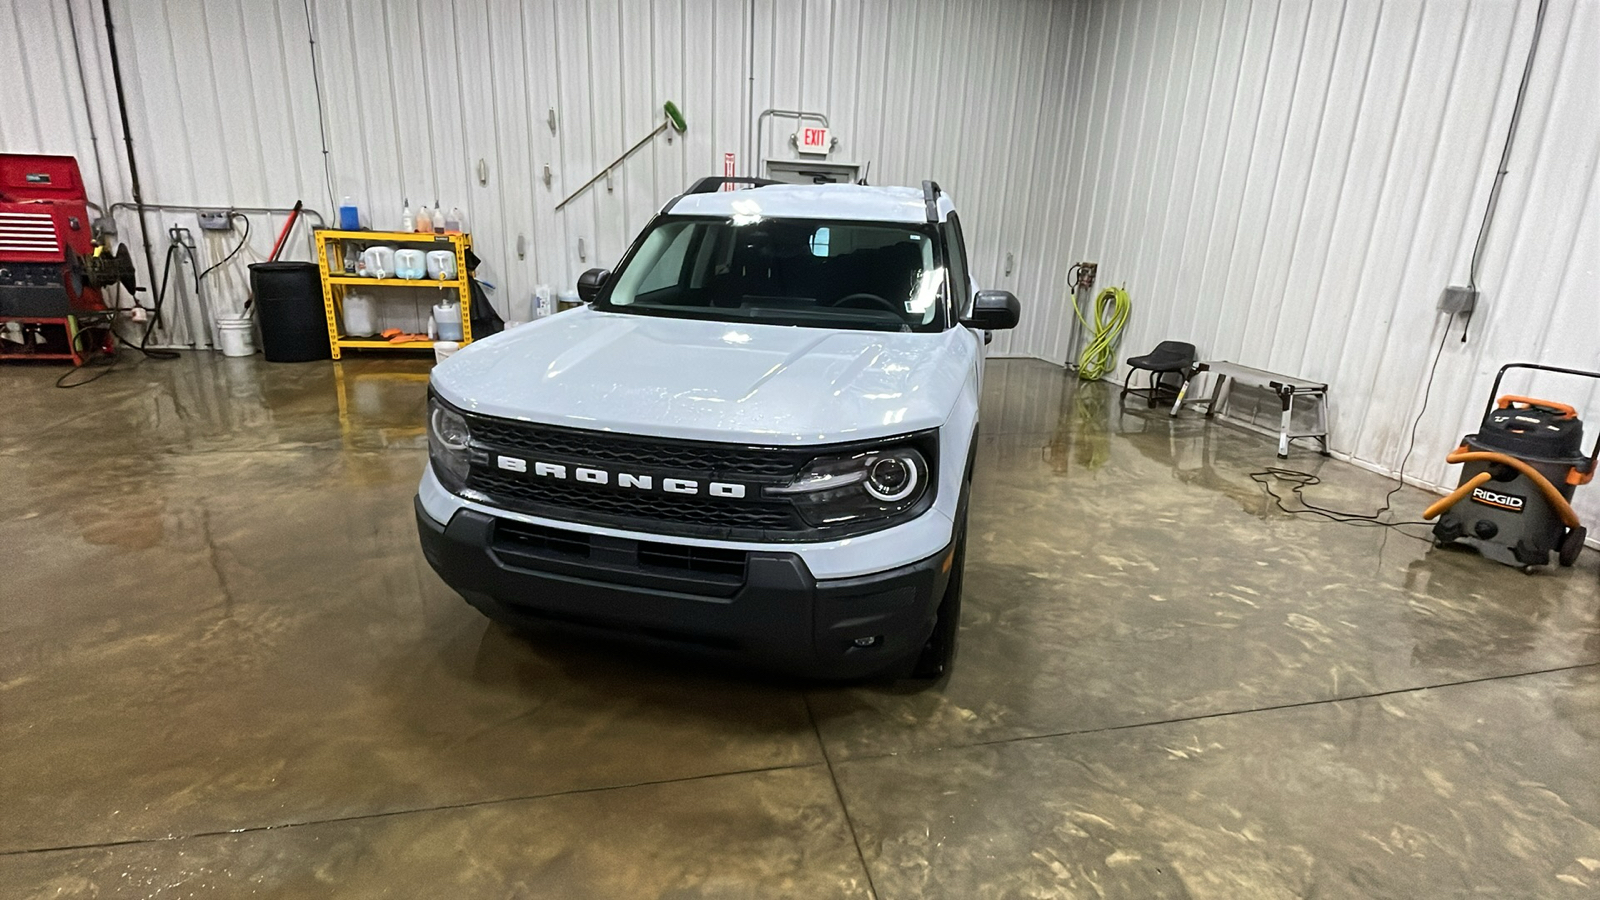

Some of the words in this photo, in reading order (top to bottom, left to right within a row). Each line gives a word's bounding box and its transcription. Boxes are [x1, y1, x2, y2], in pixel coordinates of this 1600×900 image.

[804, 128, 826, 146] EXIT
[497, 455, 746, 499] BRONCO
[1473, 487, 1523, 507] RIDGID
